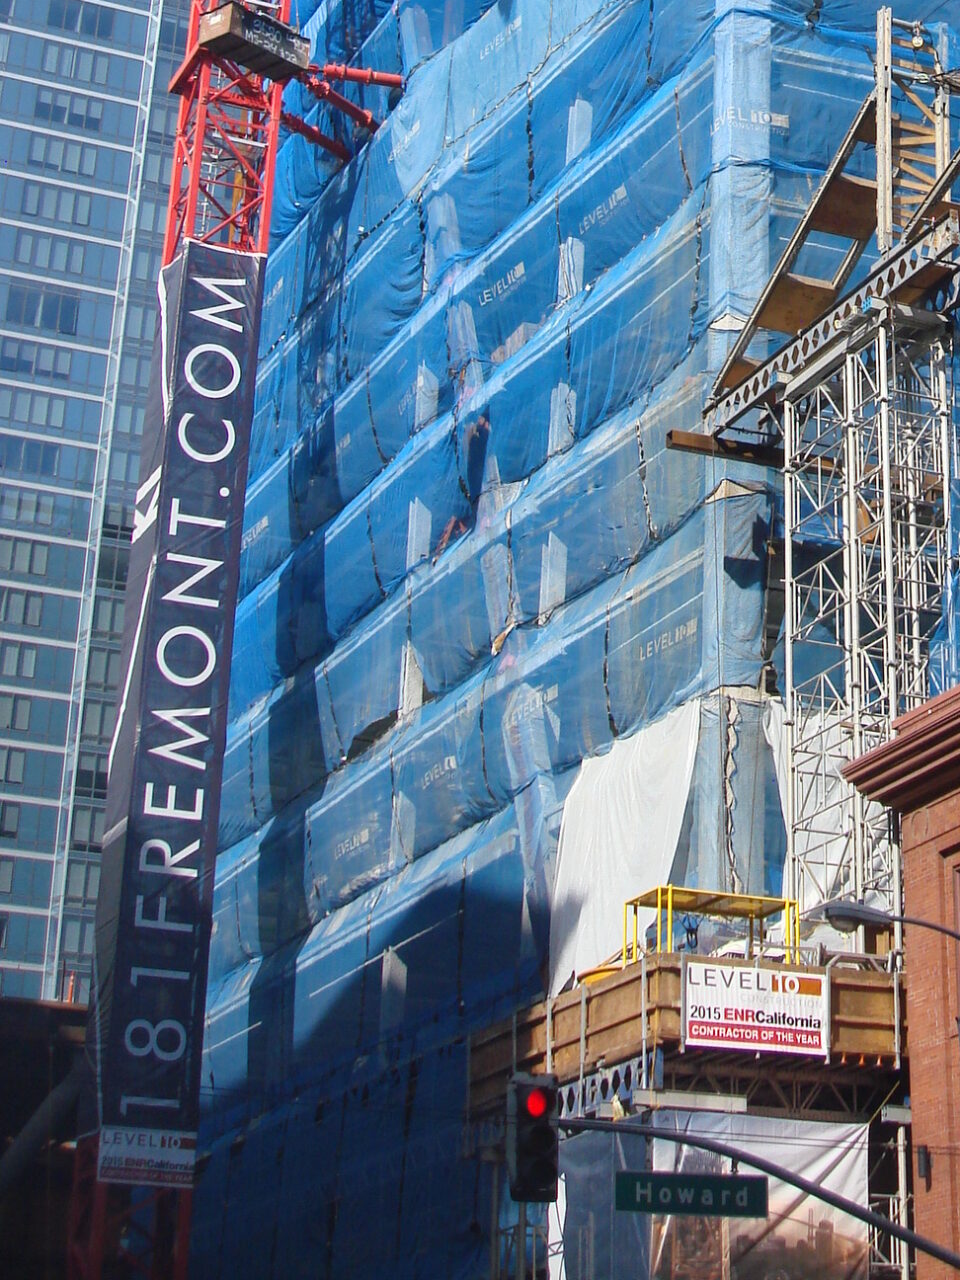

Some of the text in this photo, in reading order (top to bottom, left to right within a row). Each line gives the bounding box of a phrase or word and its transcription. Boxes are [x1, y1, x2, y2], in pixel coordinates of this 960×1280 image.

[690, 1005, 721, 1021] 2015
[691, 1024, 820, 1045] CONTRACTOR OF THE YEAR
[636, 1181, 749, 1208] Howard
